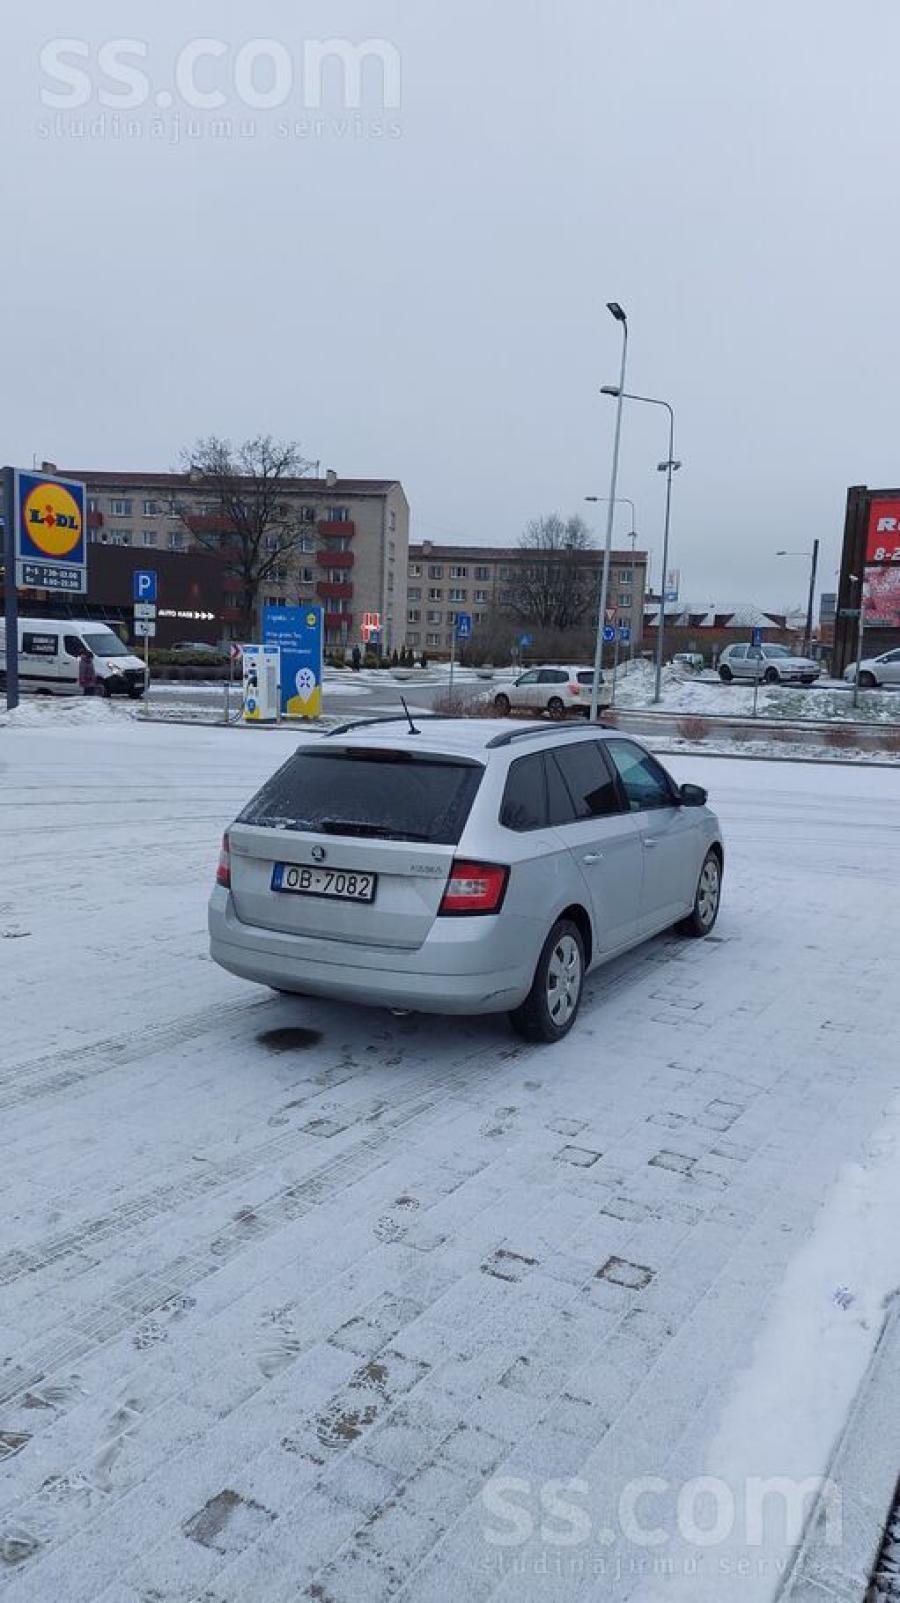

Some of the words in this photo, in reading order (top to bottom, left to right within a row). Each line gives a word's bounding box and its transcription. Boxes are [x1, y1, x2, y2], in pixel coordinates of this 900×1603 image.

[876, 517, 900, 533] R
[138, 575, 151, 597] P
[286, 867, 371, 897] OB-7082
